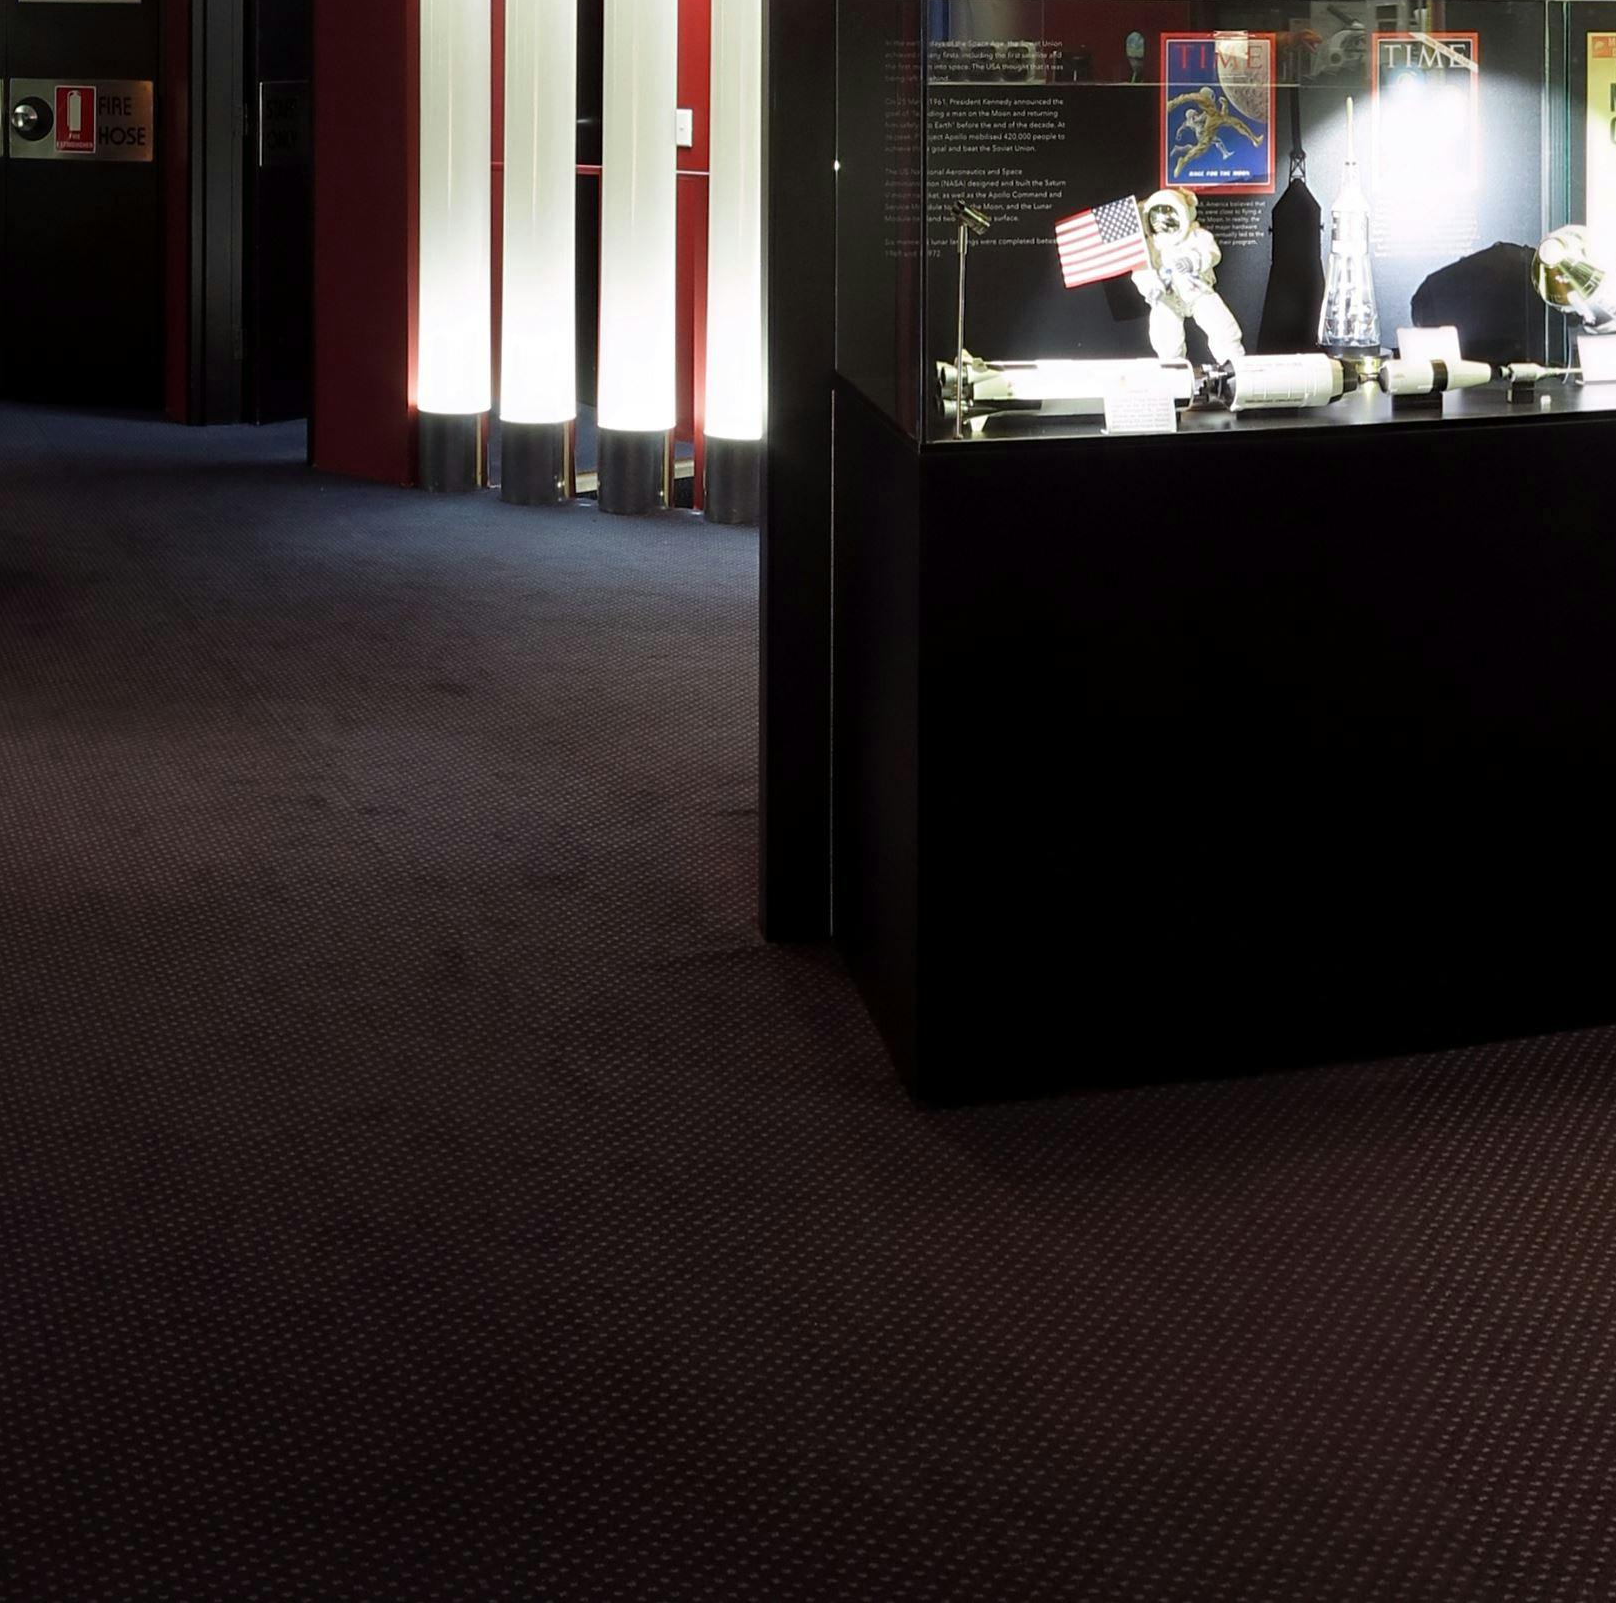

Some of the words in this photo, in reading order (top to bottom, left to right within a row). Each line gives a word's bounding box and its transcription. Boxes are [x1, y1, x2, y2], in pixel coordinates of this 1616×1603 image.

[1178, 46, 1264, 70] TIME
[1384, 44, 1467, 69] TIME
[98, 97, 132, 116] FIRE
[1027, 111, 1058, 119] returning
[98, 126, 146, 145] HOSE
